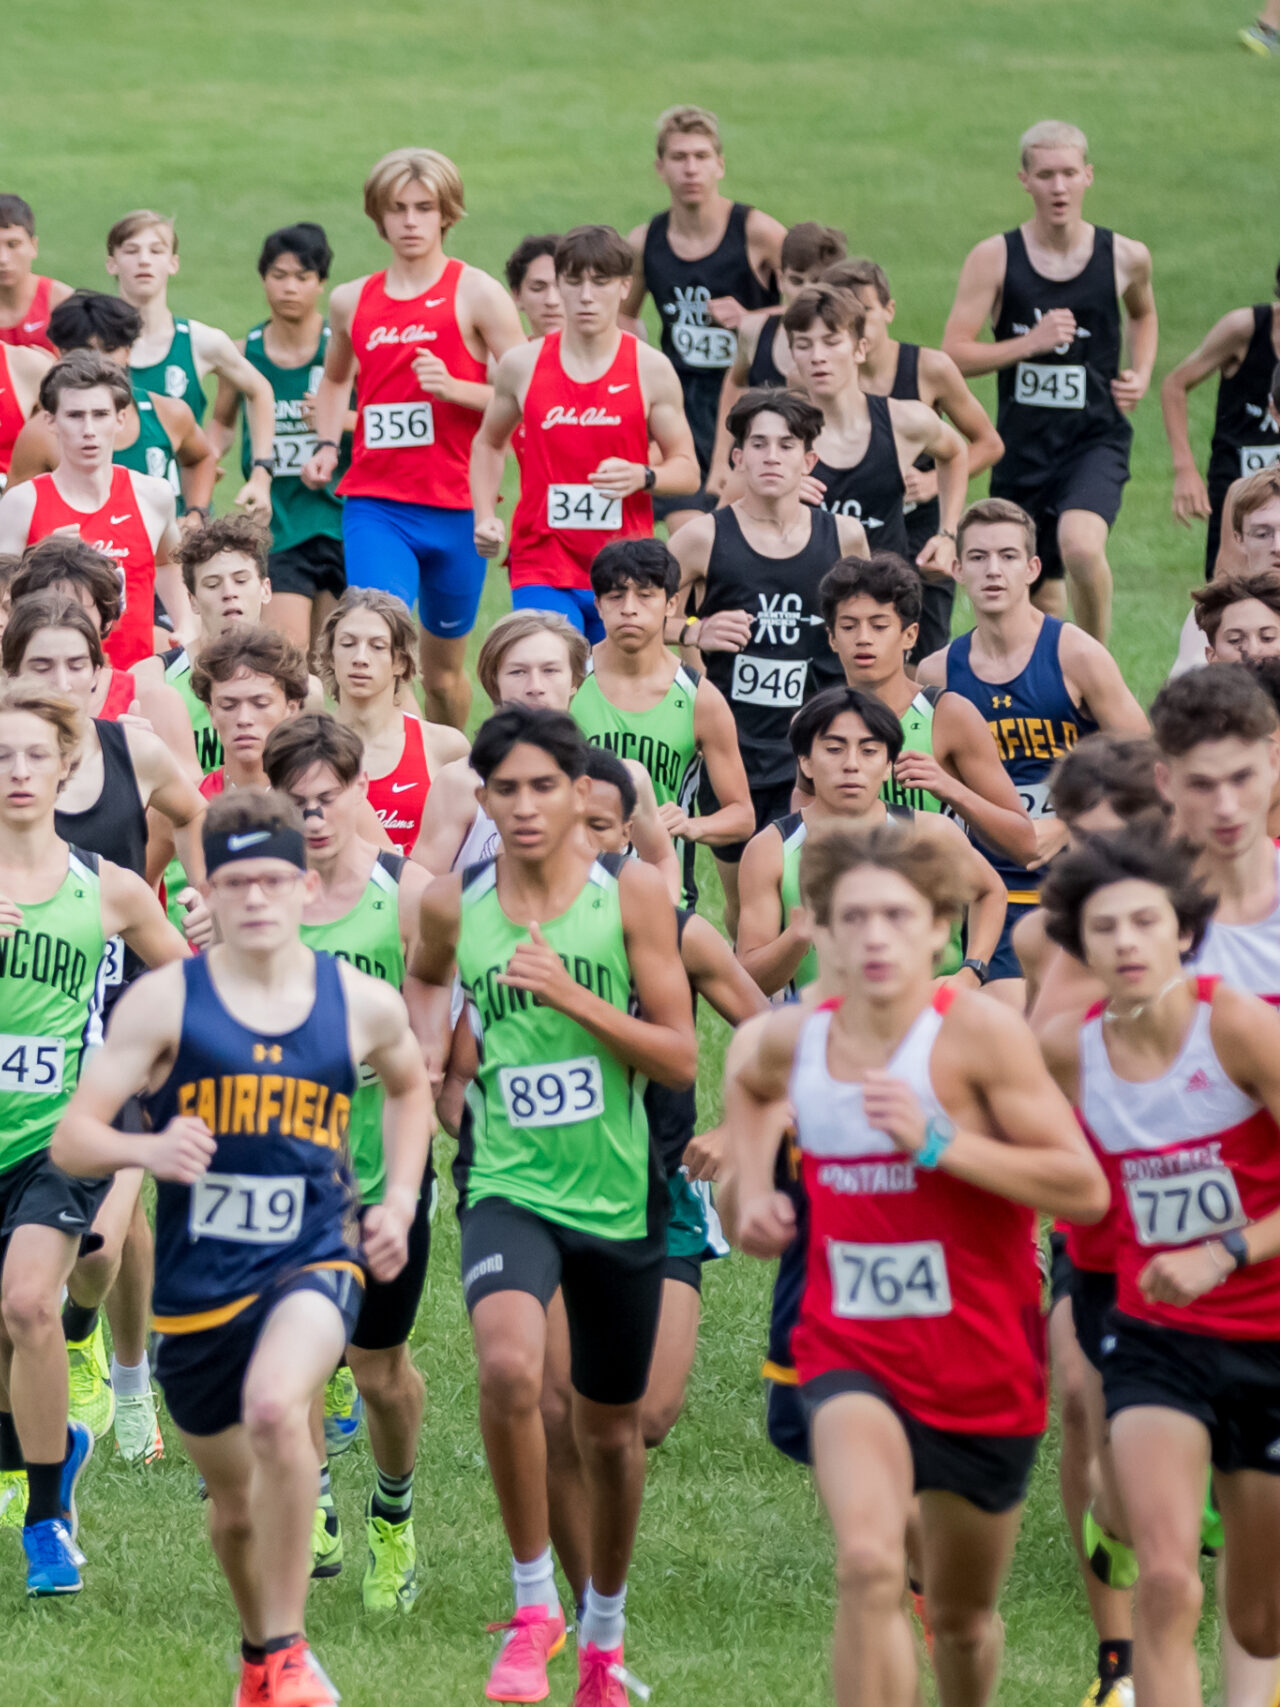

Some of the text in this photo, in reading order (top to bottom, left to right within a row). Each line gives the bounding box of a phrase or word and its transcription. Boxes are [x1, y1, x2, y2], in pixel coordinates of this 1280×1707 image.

[365, 324, 438, 351] John Adams
[678, 329, 730, 361] 943
[1021, 369, 1080, 401] 945
[369, 409, 428, 441] 356
[541, 405, 622, 430] John Adams
[553, 490, 616, 521] 347
[754, 593, 803, 645] XC
[738, 663, 802, 699] 946
[509, 1067, 598, 1119] 893
[204, 1183, 297, 1234] 719
[1136, 1180, 1235, 1234] 770
[841, 1255, 938, 1307] 764
